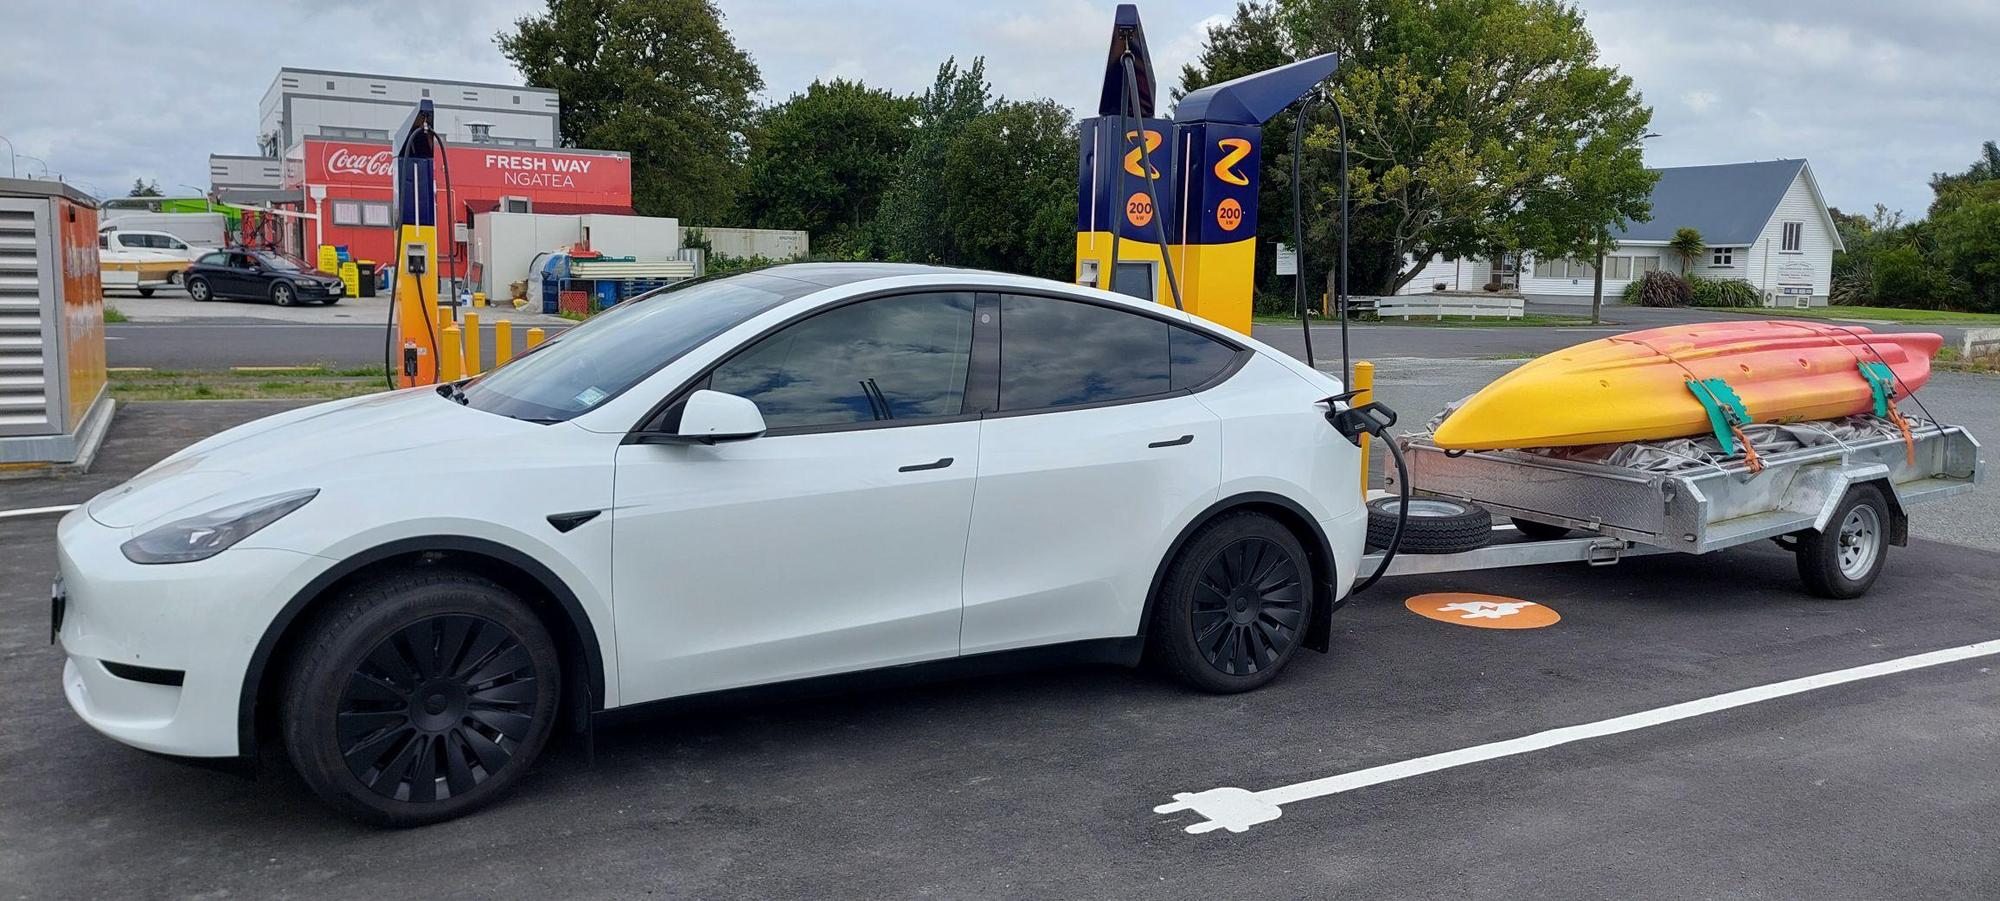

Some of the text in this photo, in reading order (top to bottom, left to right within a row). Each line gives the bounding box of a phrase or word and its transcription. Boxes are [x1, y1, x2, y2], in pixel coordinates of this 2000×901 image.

[328, 148, 394, 176] Coca-Col
[485, 154, 592, 173] FRESH WAY
[1214, 138, 1252, 186] Z
[504, 171, 575, 188] NGATEA
[1129, 202, 1152, 214] 200
[1220, 207, 1240, 219] 200
